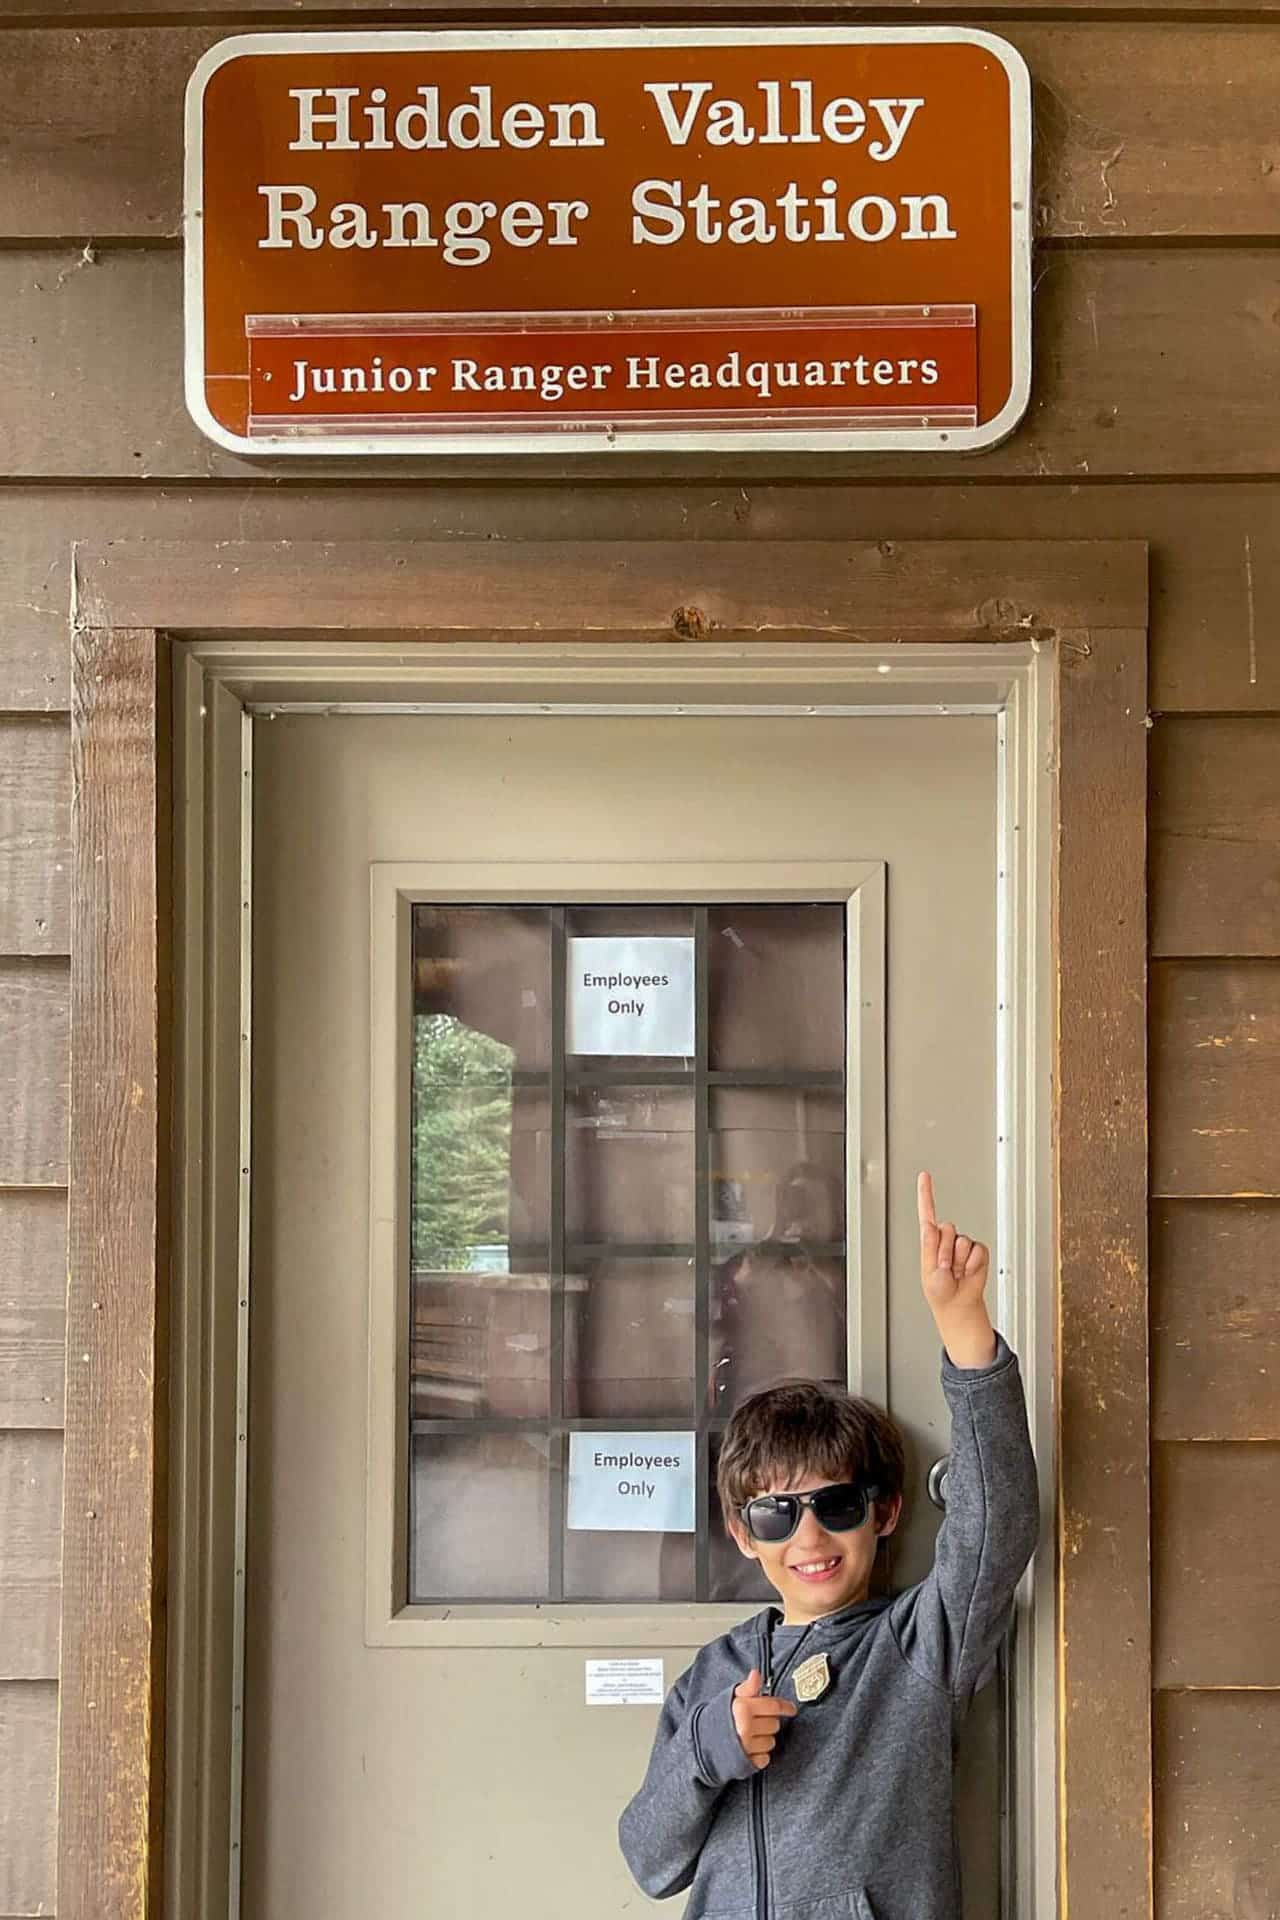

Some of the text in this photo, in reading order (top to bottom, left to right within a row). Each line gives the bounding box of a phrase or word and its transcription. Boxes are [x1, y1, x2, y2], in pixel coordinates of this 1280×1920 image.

[288, 81, 925, 162] Hidden Valley
[257, 179, 957, 266] Ranger Station
[290, 351, 940, 403] Junior Ranger Headquarters
[583, 972, 669, 990] Employees
[607, 1000, 645, 1017] Only
[594, 1452, 681, 1470] Employees
[618, 1480, 656, 1499] Only
